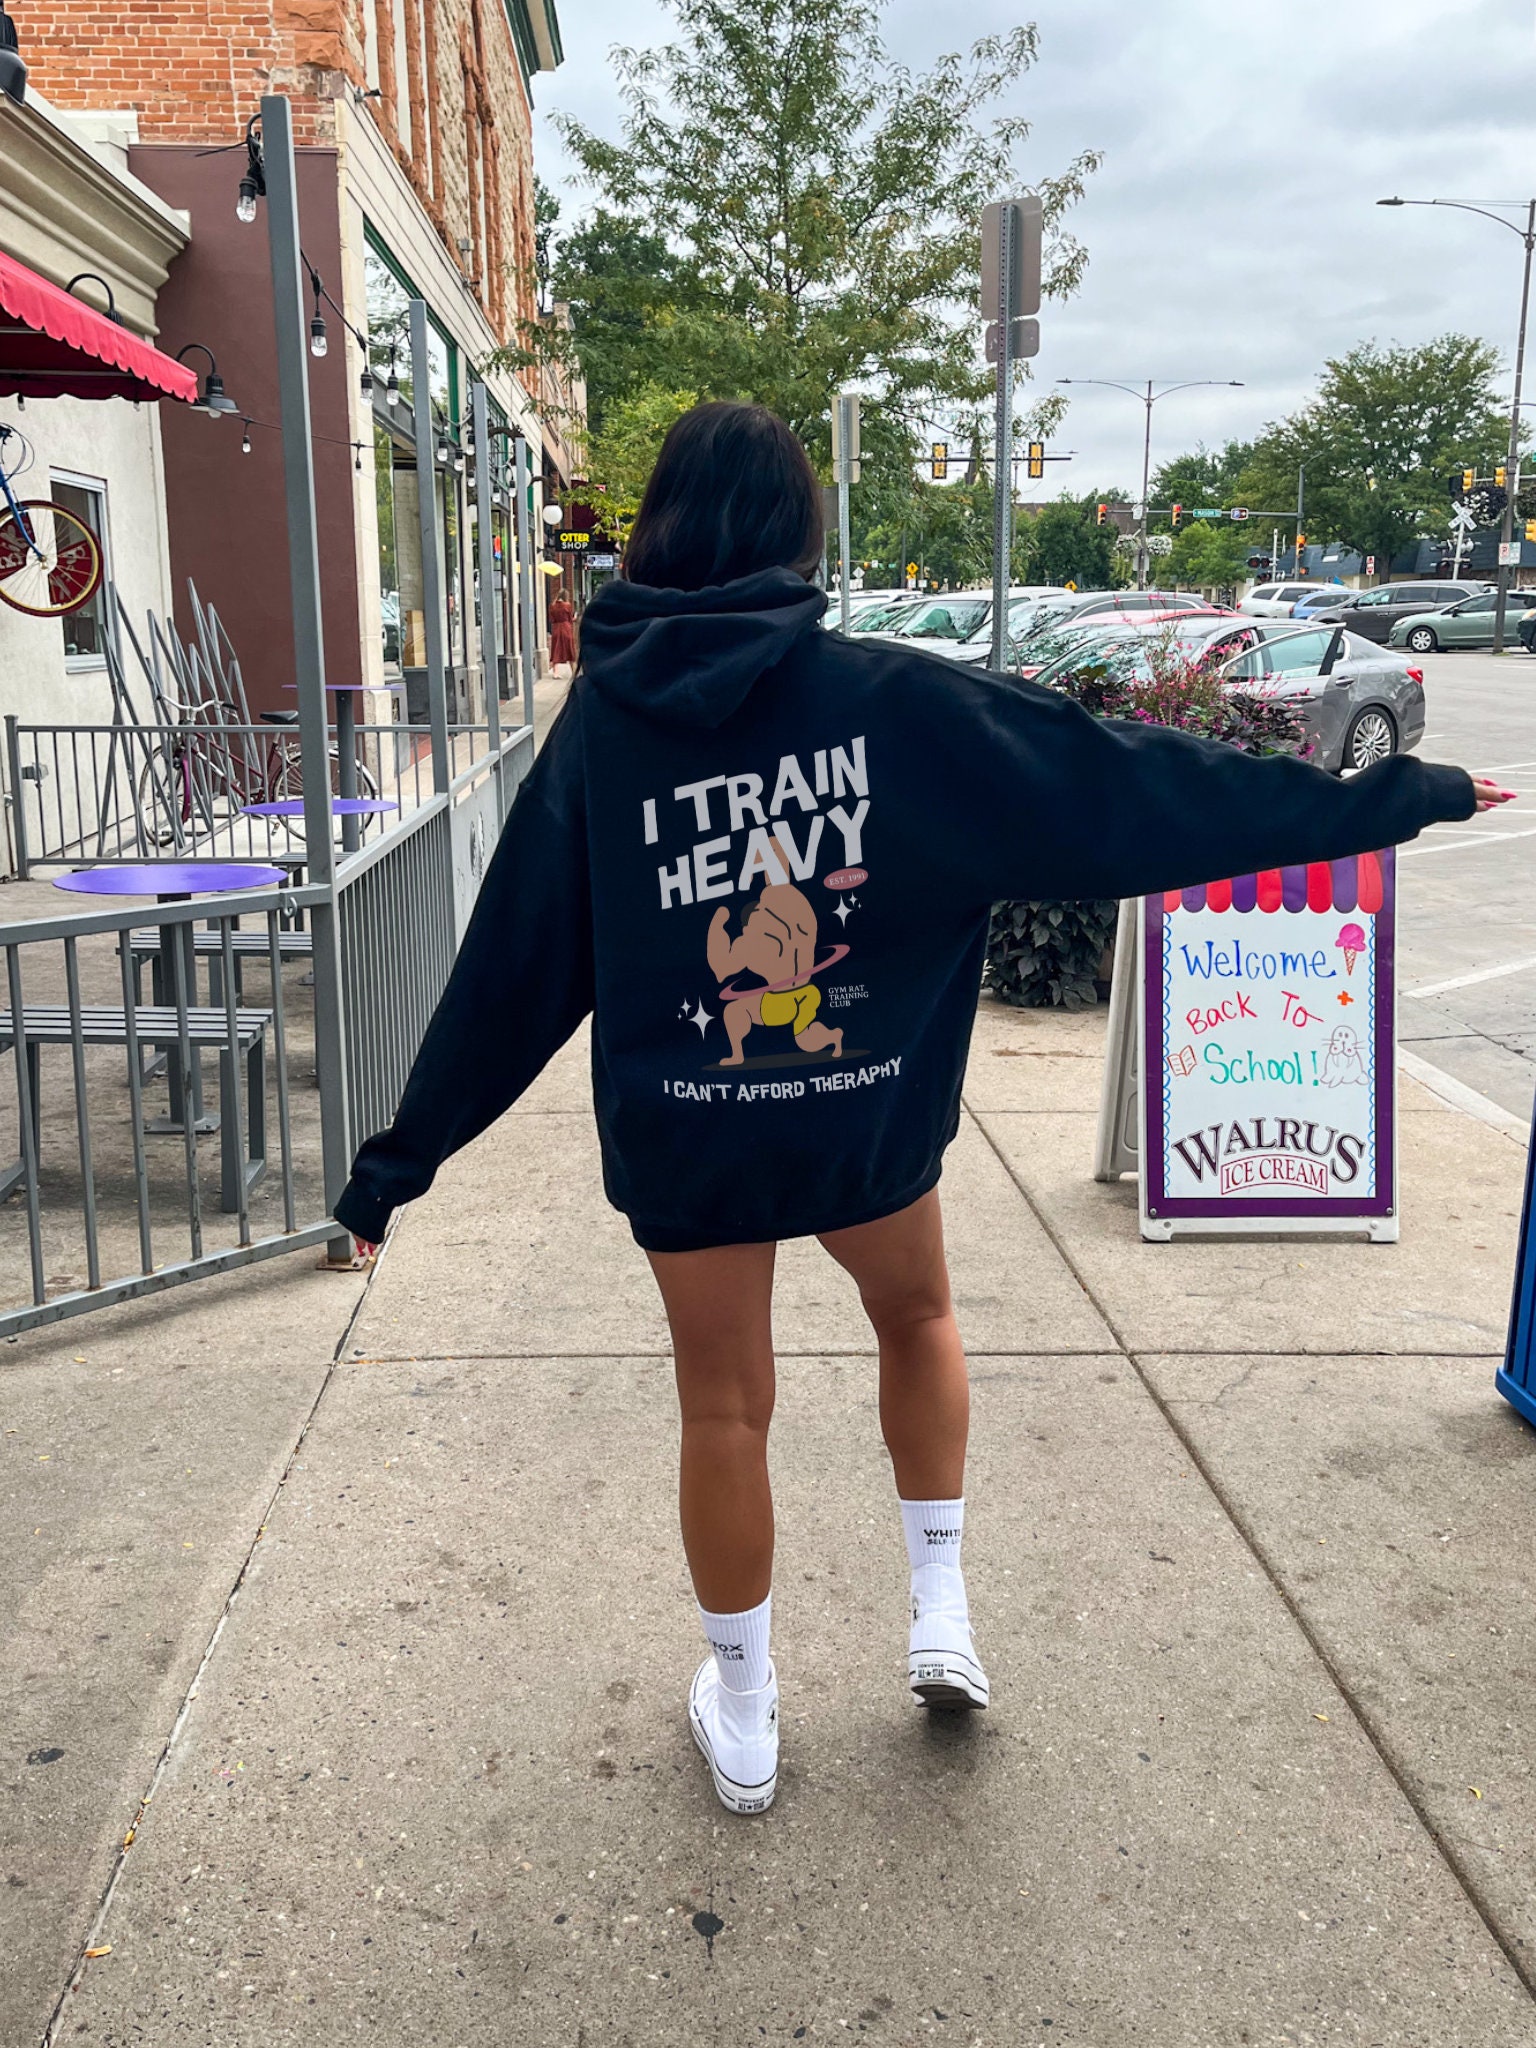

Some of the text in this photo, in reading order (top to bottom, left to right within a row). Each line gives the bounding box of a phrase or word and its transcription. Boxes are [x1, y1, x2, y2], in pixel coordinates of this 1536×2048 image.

[560, 533, 590, 542] OTTER
[642, 735, 870, 845] I TRAIN
[658, 799, 871, 910] HEAVY
[828, 872, 865, 886] EST. 1991
[1180, 939, 1337, 980] Welcome
[828, 984, 865, 994] GYM RAT
[828, 991, 869, 1001] TRAINING
[830, 1000, 851, 1008] CLUB
[1186, 990, 1324, 1035] Back To
[663, 1055, 902, 1102] I CAN'T AFFORD THERAPHY
[1170, 1116, 1366, 1184] WALRUS
[1225, 1157, 1325, 1190] ICE CREAM
